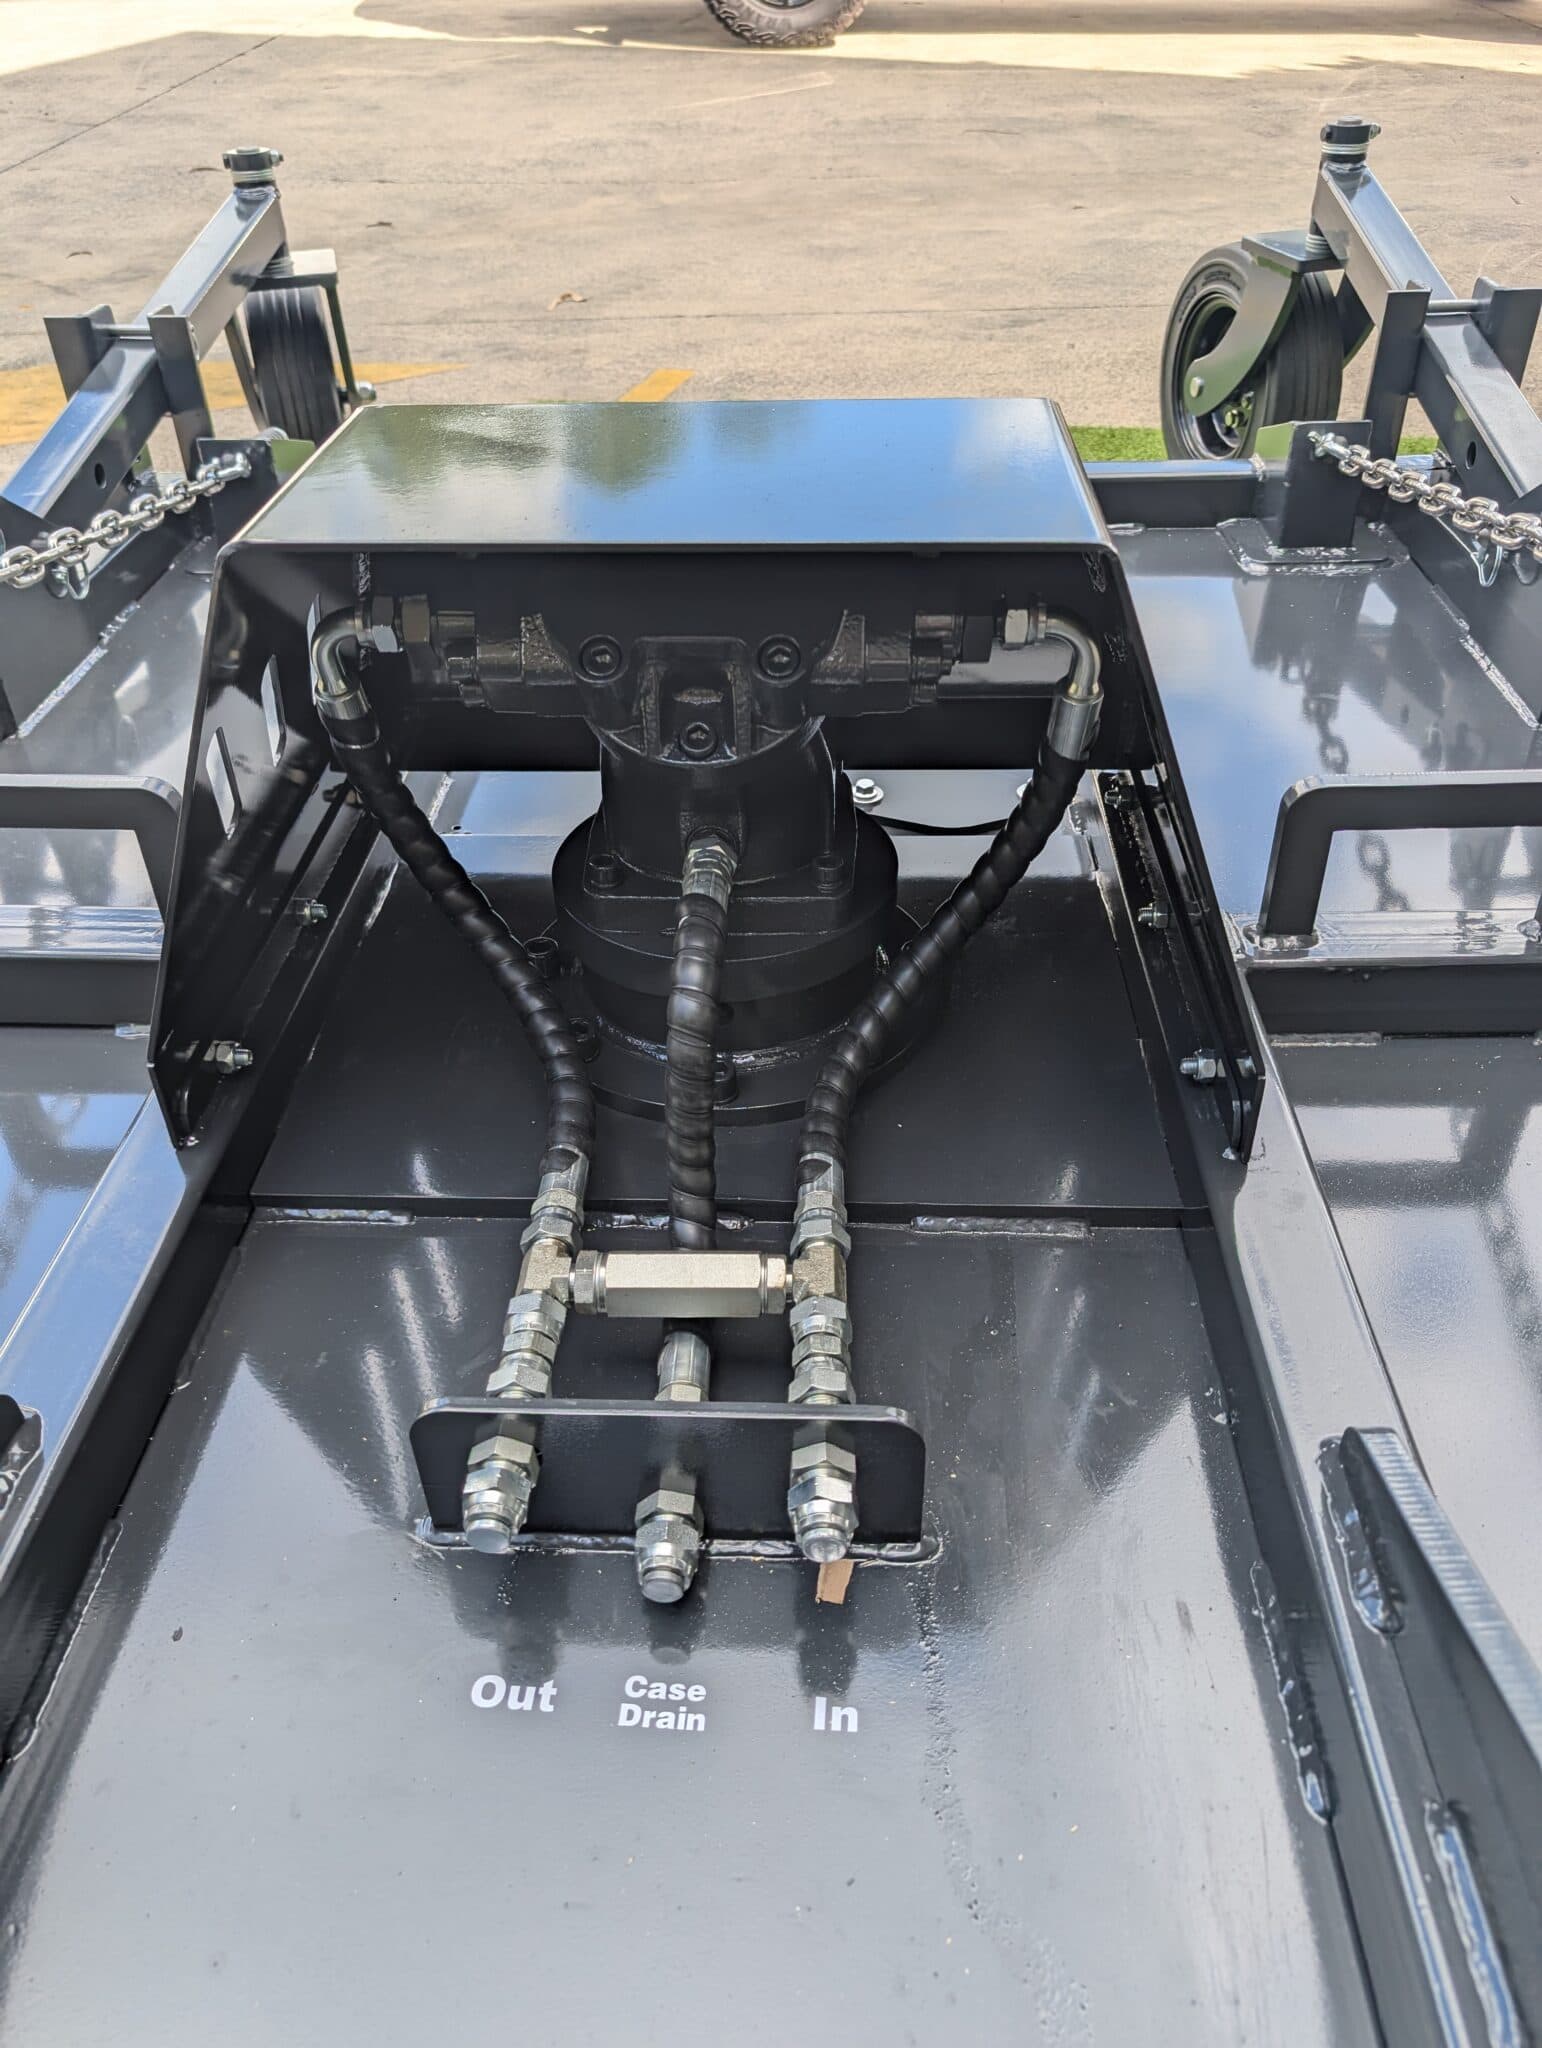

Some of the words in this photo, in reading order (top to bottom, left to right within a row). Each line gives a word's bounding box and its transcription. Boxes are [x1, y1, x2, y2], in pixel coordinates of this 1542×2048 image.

[471, 1674, 557, 1712] Out
[624, 1675, 707, 1702] Case
[617, 1702, 706, 1732] Drain
[813, 1696, 859, 1733] In
